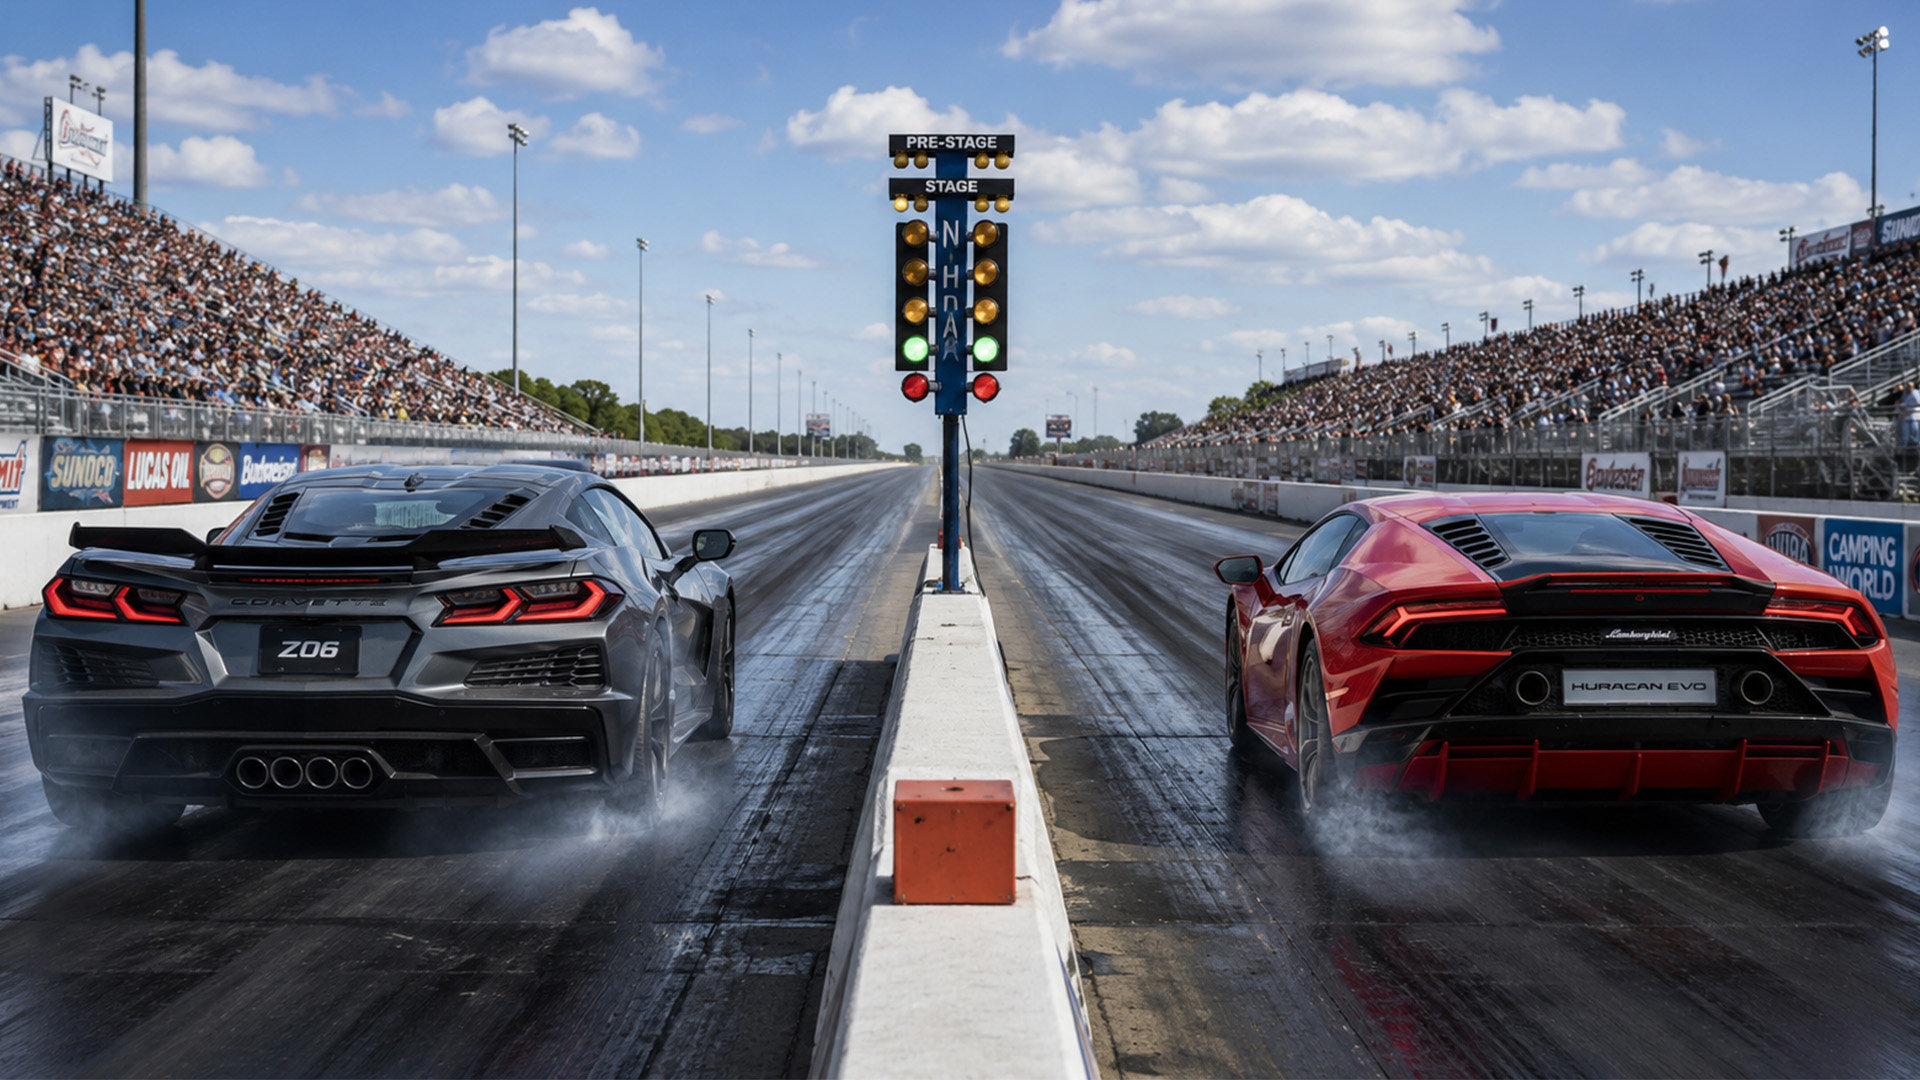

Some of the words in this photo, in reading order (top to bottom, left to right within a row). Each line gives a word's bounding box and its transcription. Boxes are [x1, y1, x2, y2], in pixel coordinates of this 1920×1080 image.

[906, 136, 998, 149] PRE-STAGE
[925, 180, 978, 193] STAGE
[127, 451, 170, 490] LUCAS
[171, 452, 190, 489] OIL
[1828, 532, 1897, 568] CAMPING
[231, 598, 388, 607] CORVETTE
[277, 641, 340, 658] Z06
[1571, 682, 1663, 691] HURACAN
[1667, 682, 1707, 691] EVO
